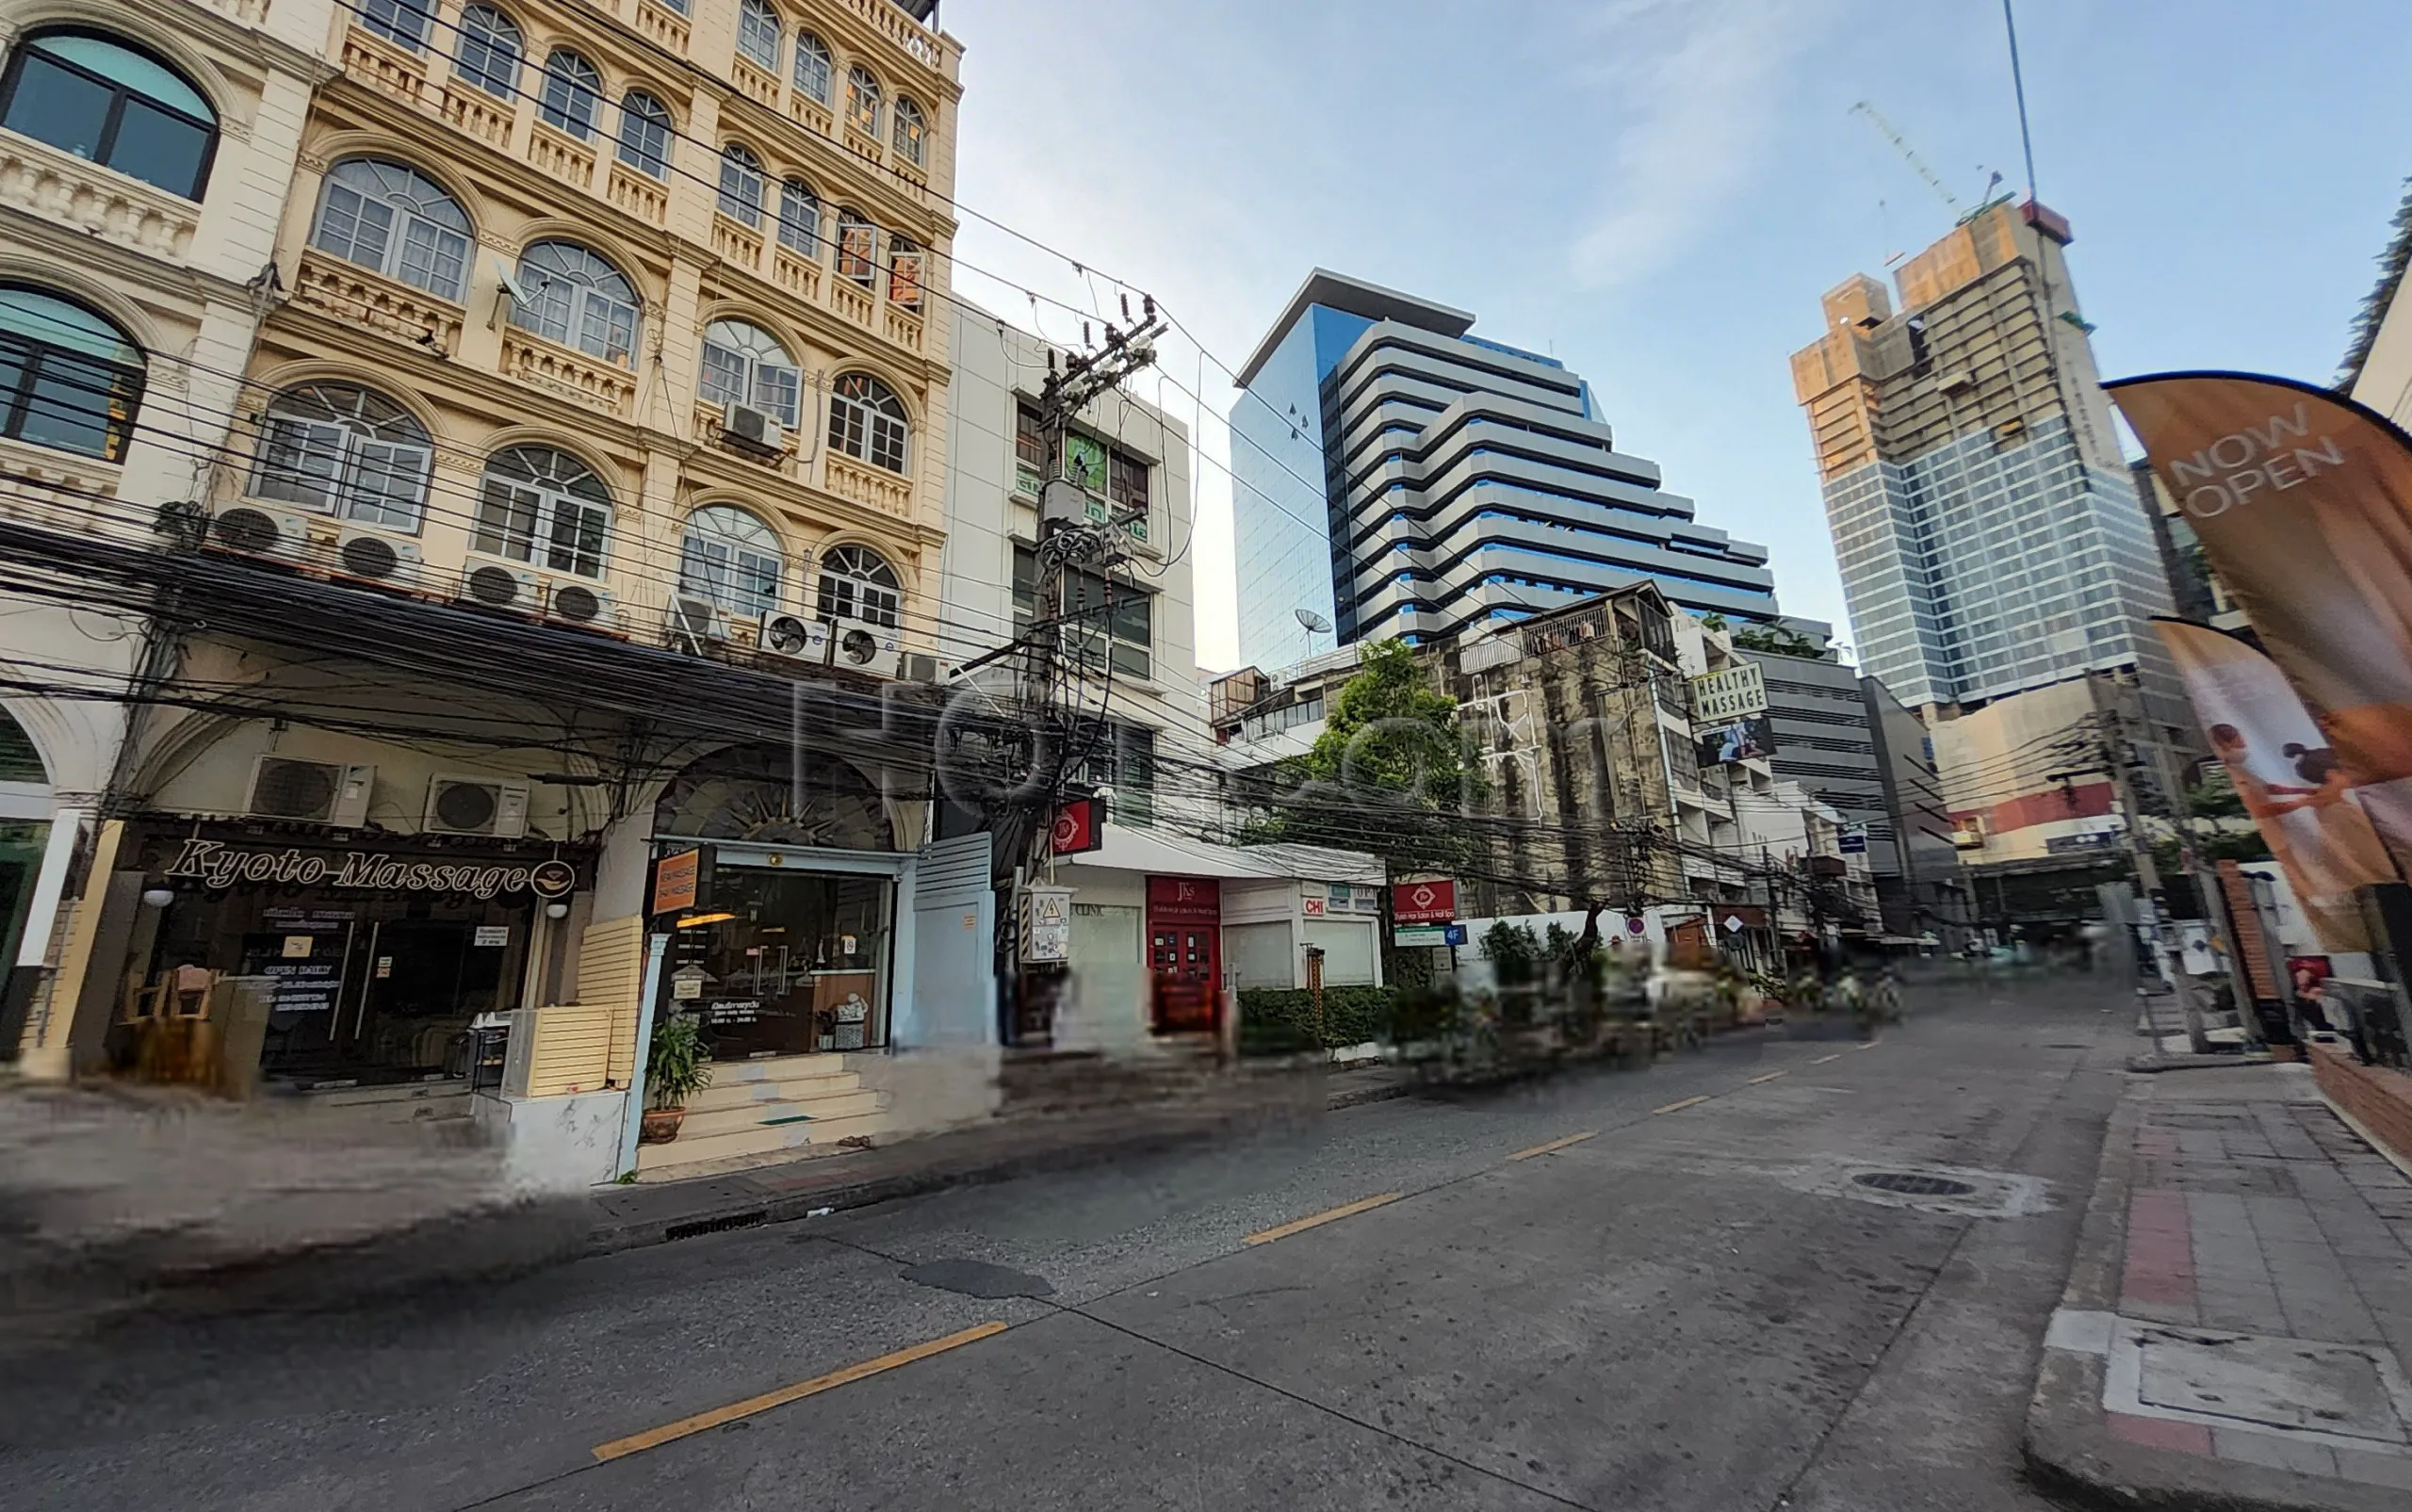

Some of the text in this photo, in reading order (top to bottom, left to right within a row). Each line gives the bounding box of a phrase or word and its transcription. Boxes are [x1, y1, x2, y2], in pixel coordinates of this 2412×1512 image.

[2171, 402, 2309, 486] NOW
[2185, 436, 2345, 518] OPEN
[1697, 667, 1758, 697] HEALTHY
[1702, 690, 1763, 717] MASSAGE
[164, 839, 526, 899] Kyoto Massage
[1075, 904, 1104, 916] CLINIC
[1446, 929, 1459, 940] 4F
